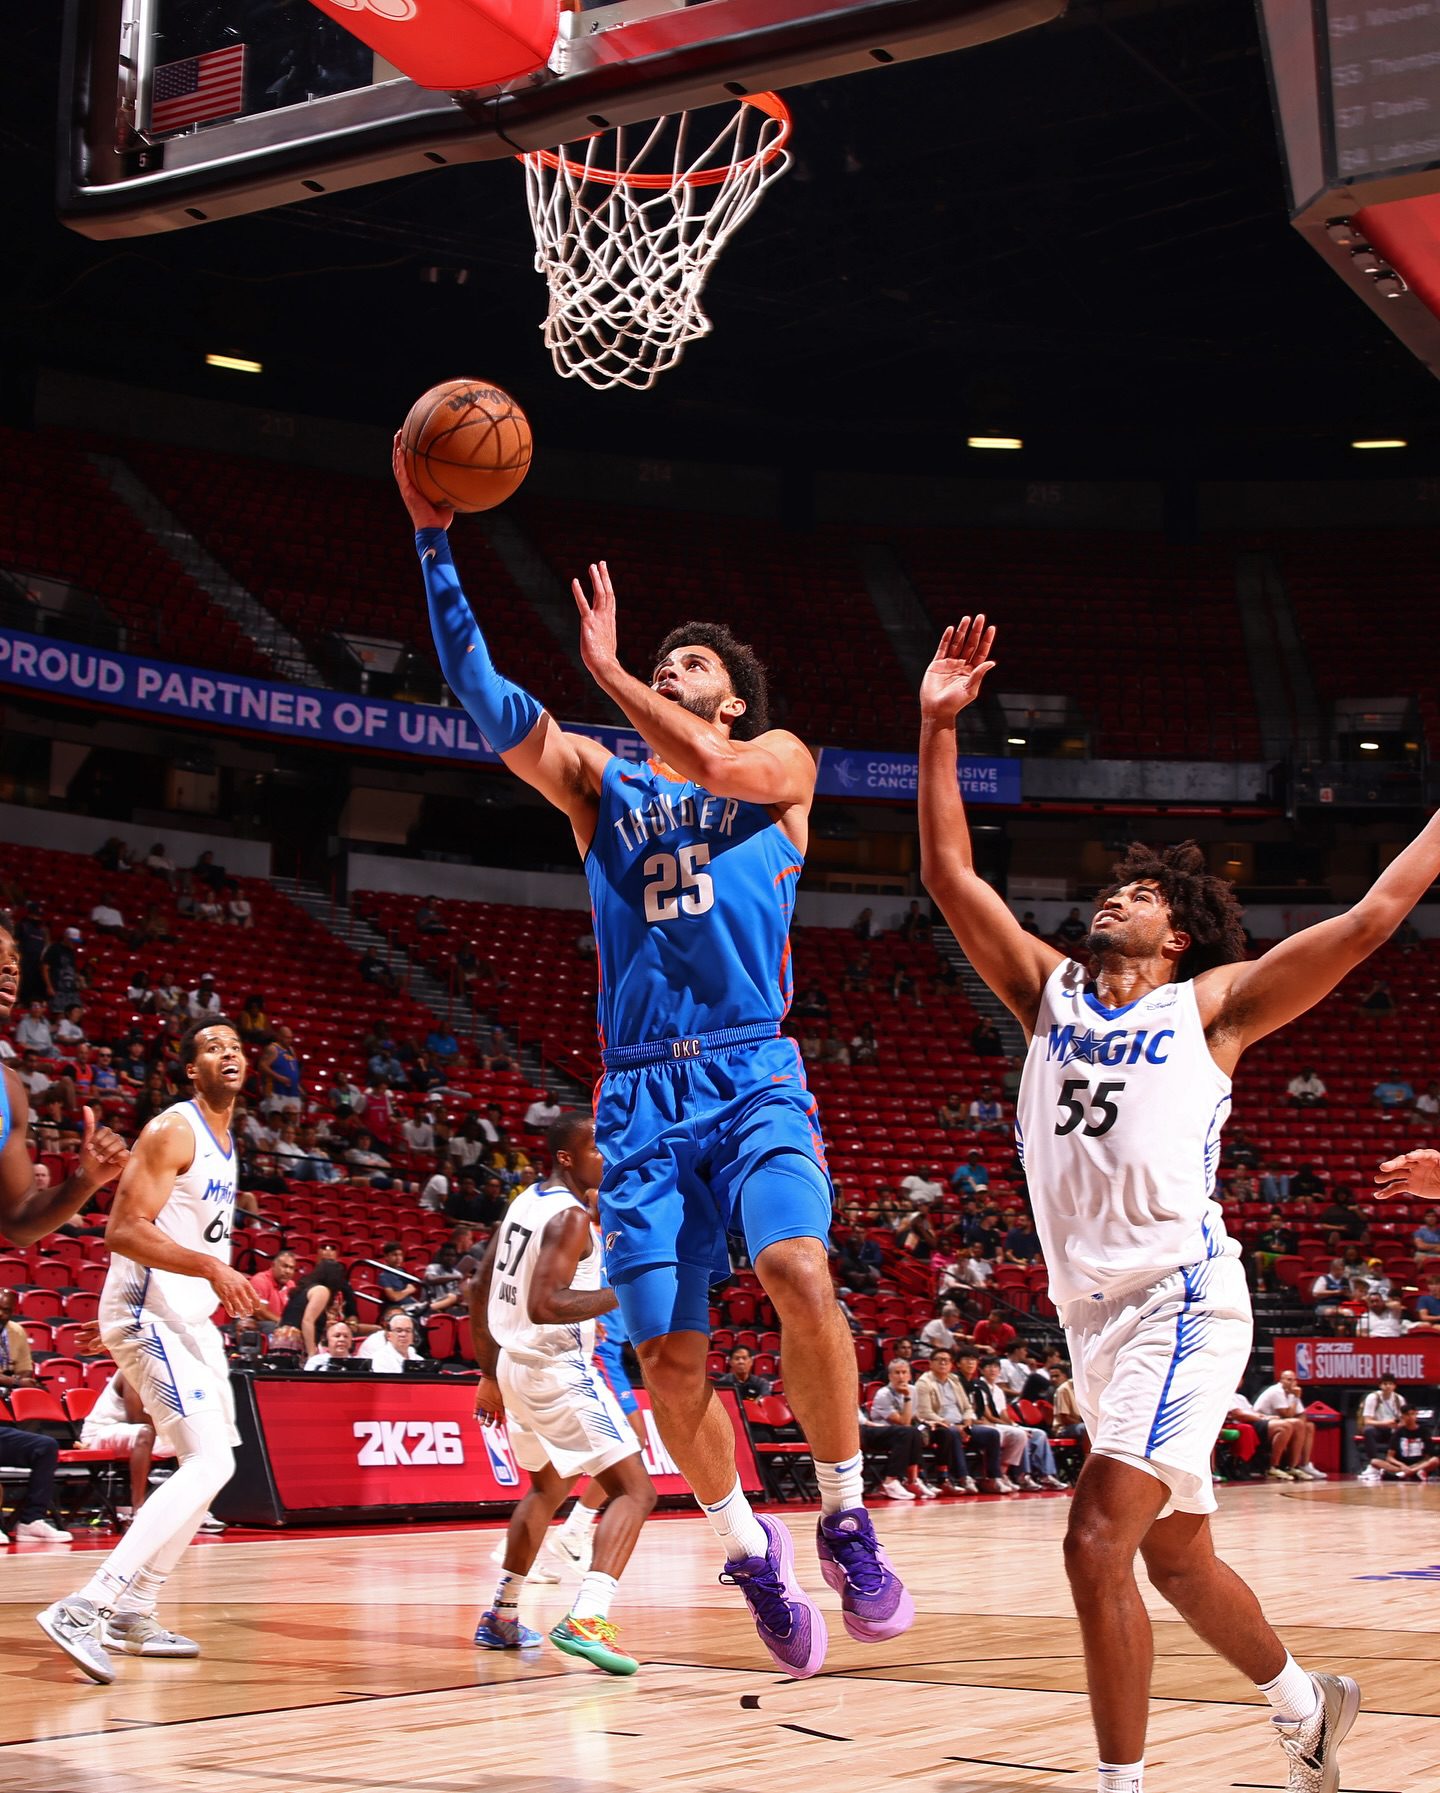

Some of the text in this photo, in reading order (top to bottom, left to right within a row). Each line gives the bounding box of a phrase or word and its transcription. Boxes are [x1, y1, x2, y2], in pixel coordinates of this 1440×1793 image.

[137, 667, 321, 729] PARTNER
[333, 703, 388, 737] OF
[867, 776, 918, 789] CANCE
[614, 793, 739, 852] THUNDER
[644, 843, 715, 922] 25
[673, 1040, 700, 1058] OKC
[1055, 1080, 1126, 1137] 55
[496, 1222, 533, 1276] 57
[1315, 1343, 1354, 1353] 2K26
[1316, 1354, 1424, 1379] SUMMER LEAGUE
[353, 1421, 465, 1466] 2K26
